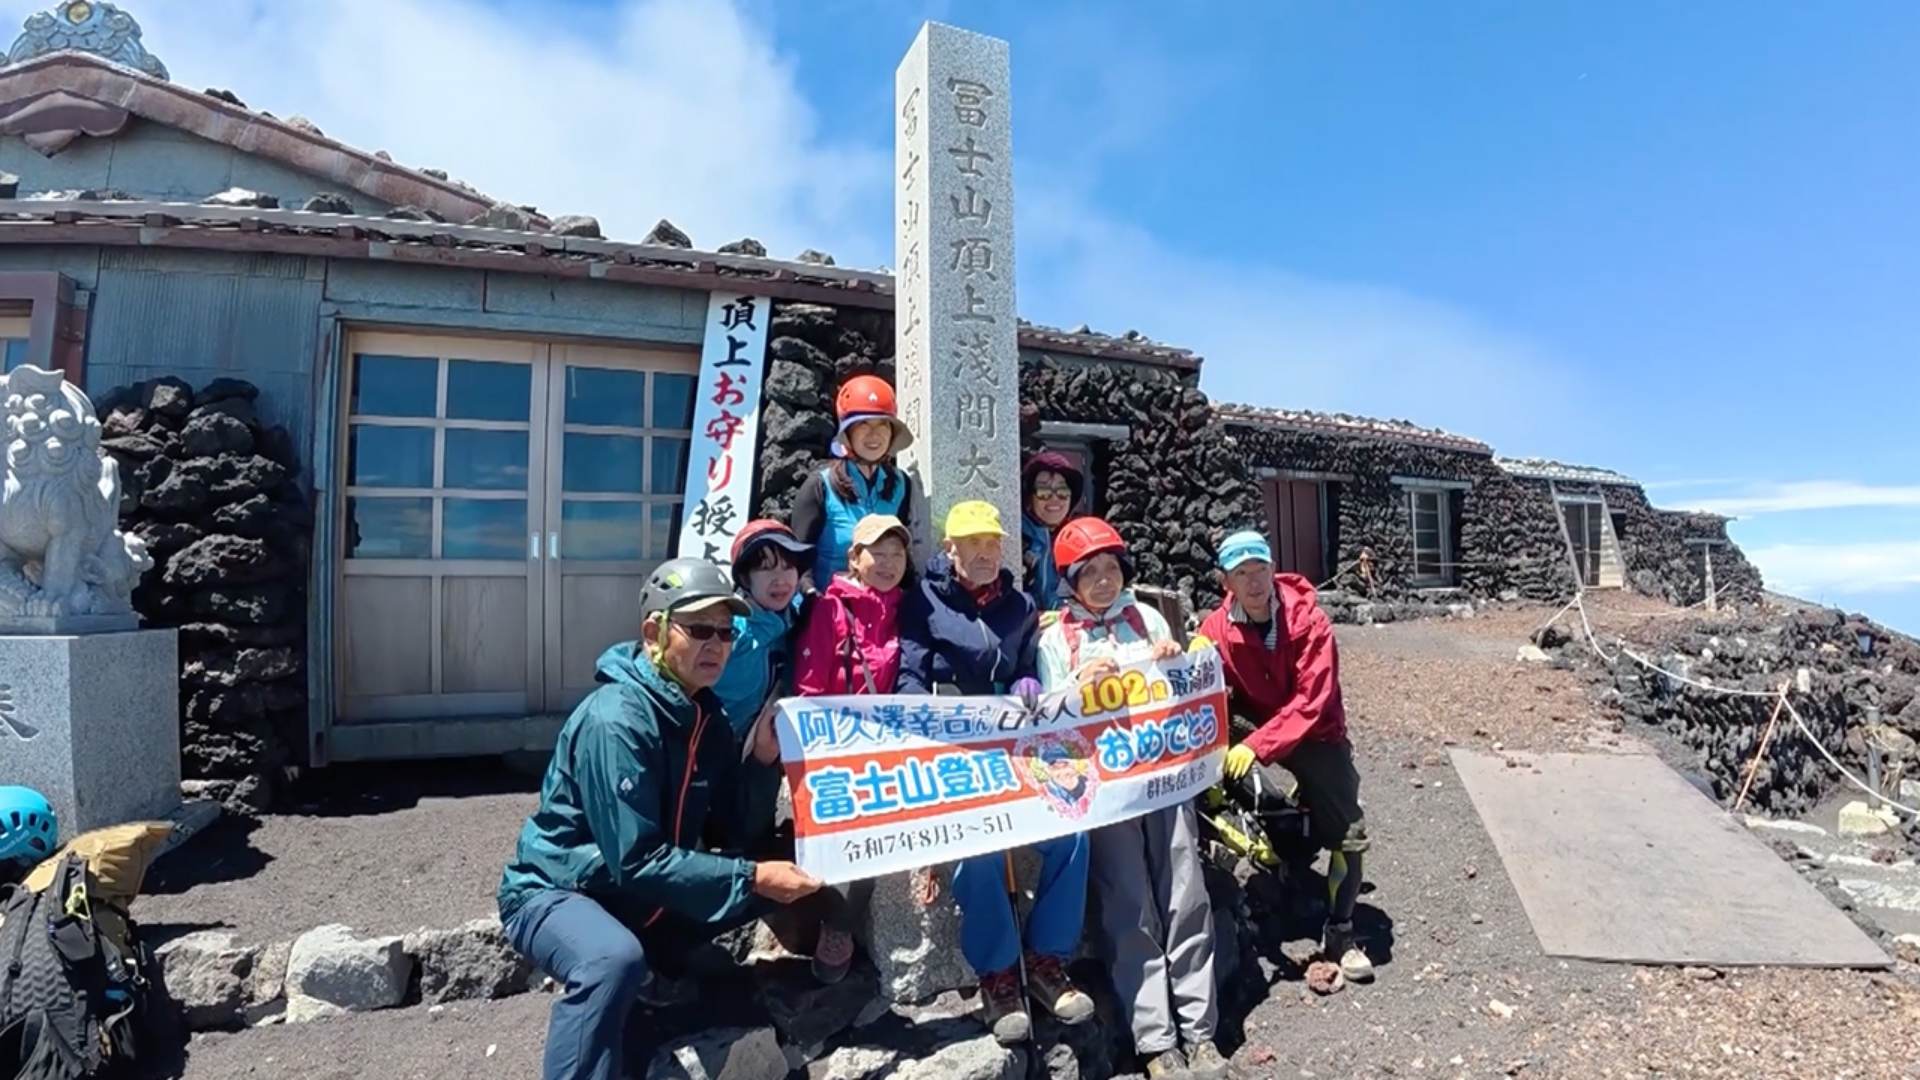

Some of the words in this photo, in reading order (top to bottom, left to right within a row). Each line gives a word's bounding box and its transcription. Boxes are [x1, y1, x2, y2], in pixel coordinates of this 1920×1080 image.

[808, 747, 1018, 821] 富士山登頂
[1096, 706, 1217, 769] おめでとう
